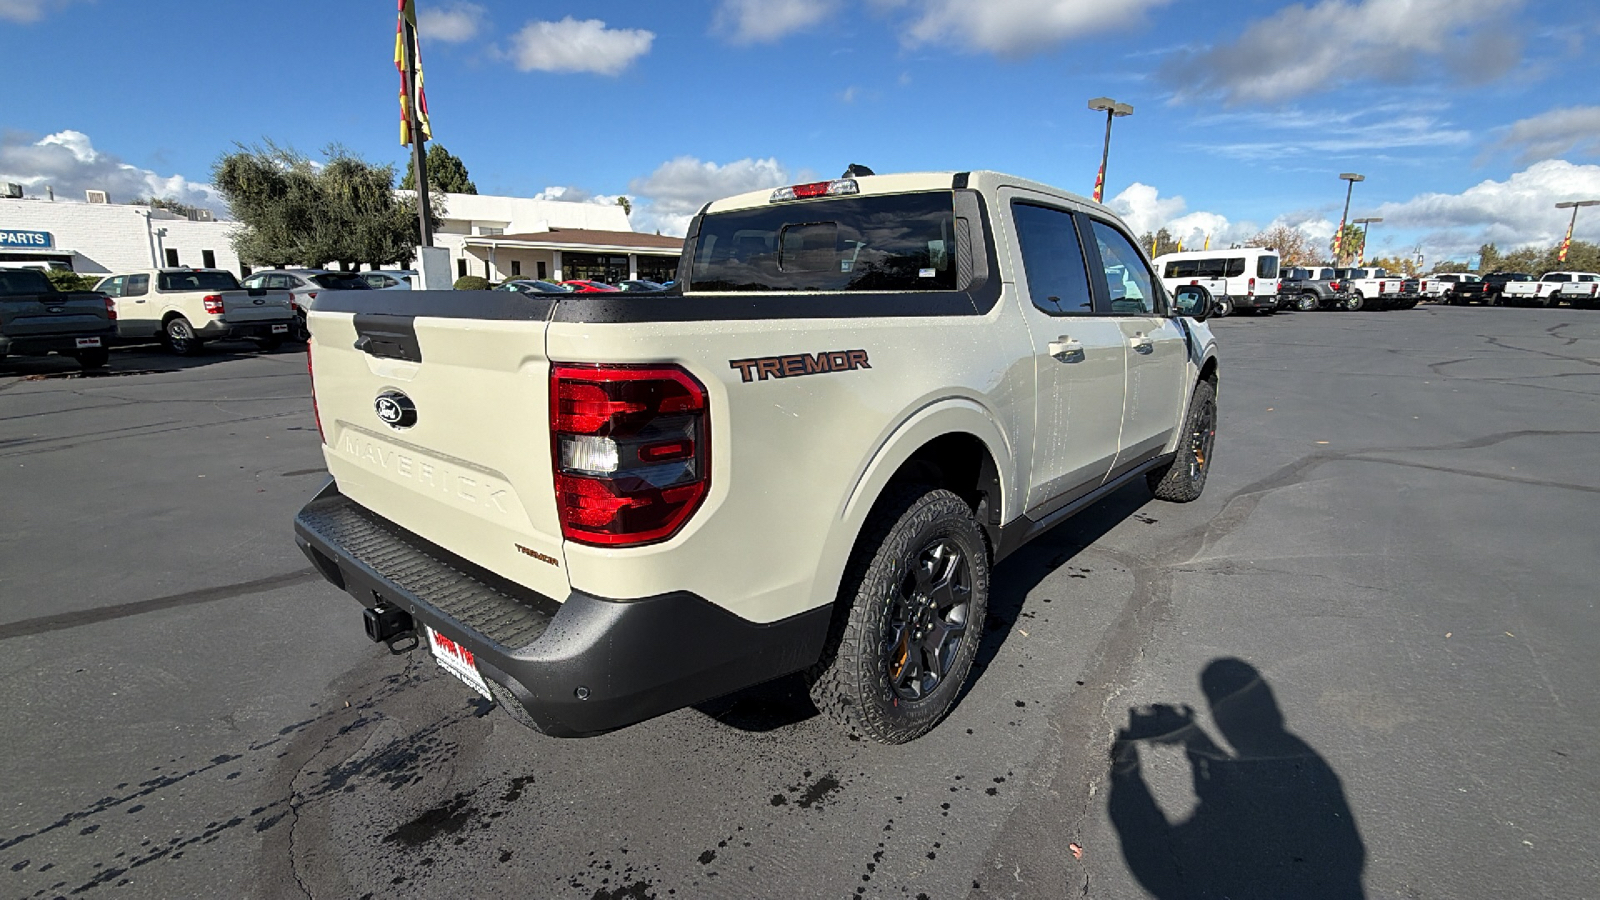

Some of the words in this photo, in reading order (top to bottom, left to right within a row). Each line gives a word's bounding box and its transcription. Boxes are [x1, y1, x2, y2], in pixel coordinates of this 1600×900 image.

[0, 232, 45, 244] PARTS
[728, 348, 873, 384] TREMOR
[378, 399, 397, 420] Ford
[344, 434, 508, 515] MAVERICK
[514, 542, 559, 568] TREMOR
